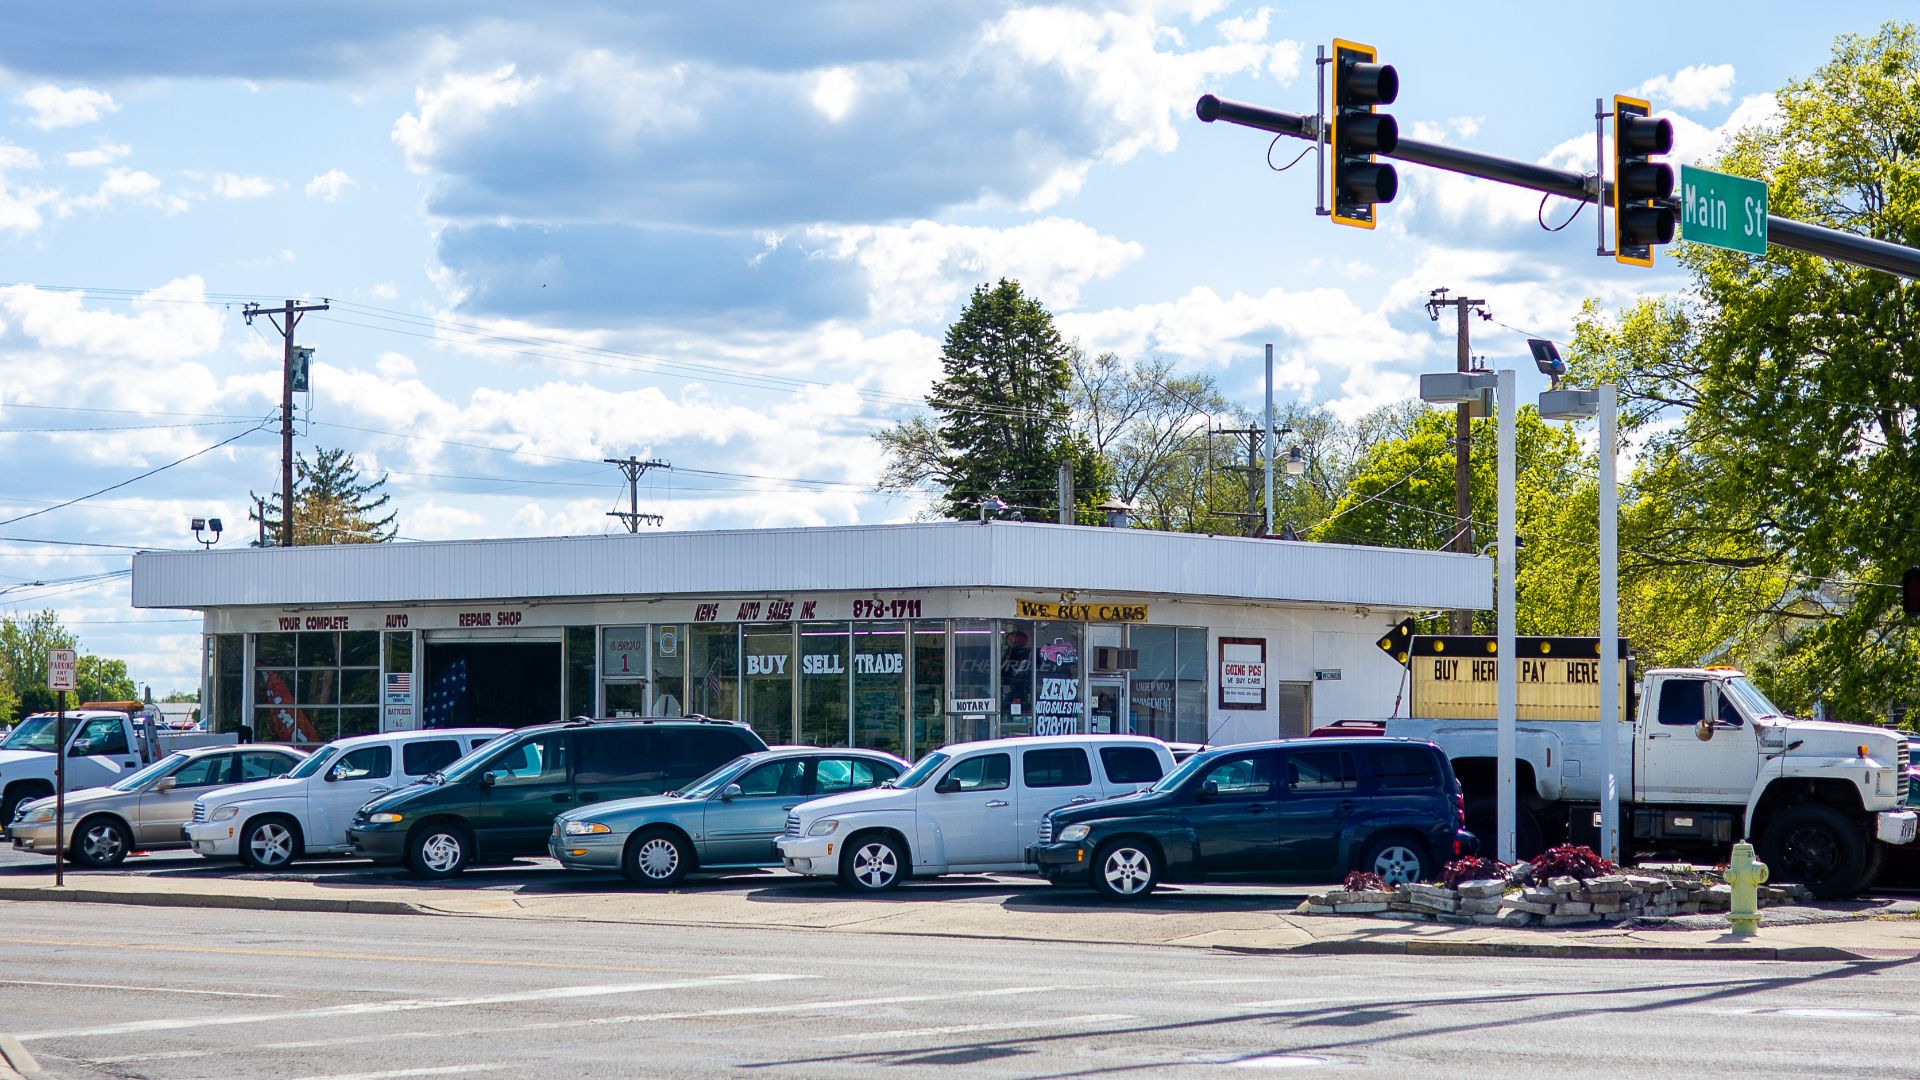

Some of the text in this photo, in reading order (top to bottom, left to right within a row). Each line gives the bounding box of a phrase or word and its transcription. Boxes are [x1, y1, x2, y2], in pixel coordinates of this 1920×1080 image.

[1685, 183, 1763, 237] Main St
[694, 603, 719, 621] KENS
[736, 602, 760, 620] AUTO
[766, 601, 794, 620] SALES
[853, 599, 922, 618] 878-1711
[1022, 601, 1145, 620] WE BUY CARS
[279, 616, 348, 630] YOUR COMPLETE
[385, 614, 408, 628] AUTO
[459, 611, 521, 626] REPAIR SHOP
[50, 662, 74, 670] PARKING
[57, 653, 67, 661] NO
[621, 653, 629, 672] 1
[747, 655, 788, 675] BUY
[803, 654, 845, 674] SELL
[855, 654, 904, 674] TRADE
[1225, 664, 1262, 677] GOING PCS
[1434, 660, 1599, 683] BUY HER PAY HERE
[1040, 678, 1079, 700] KENS
[1135, 682, 1170, 692] UNDER NEW
[956, 701, 990, 712] NOTARY
[1035, 701, 1051, 714] AUTO
[1051, 701, 1072, 714] SALES
